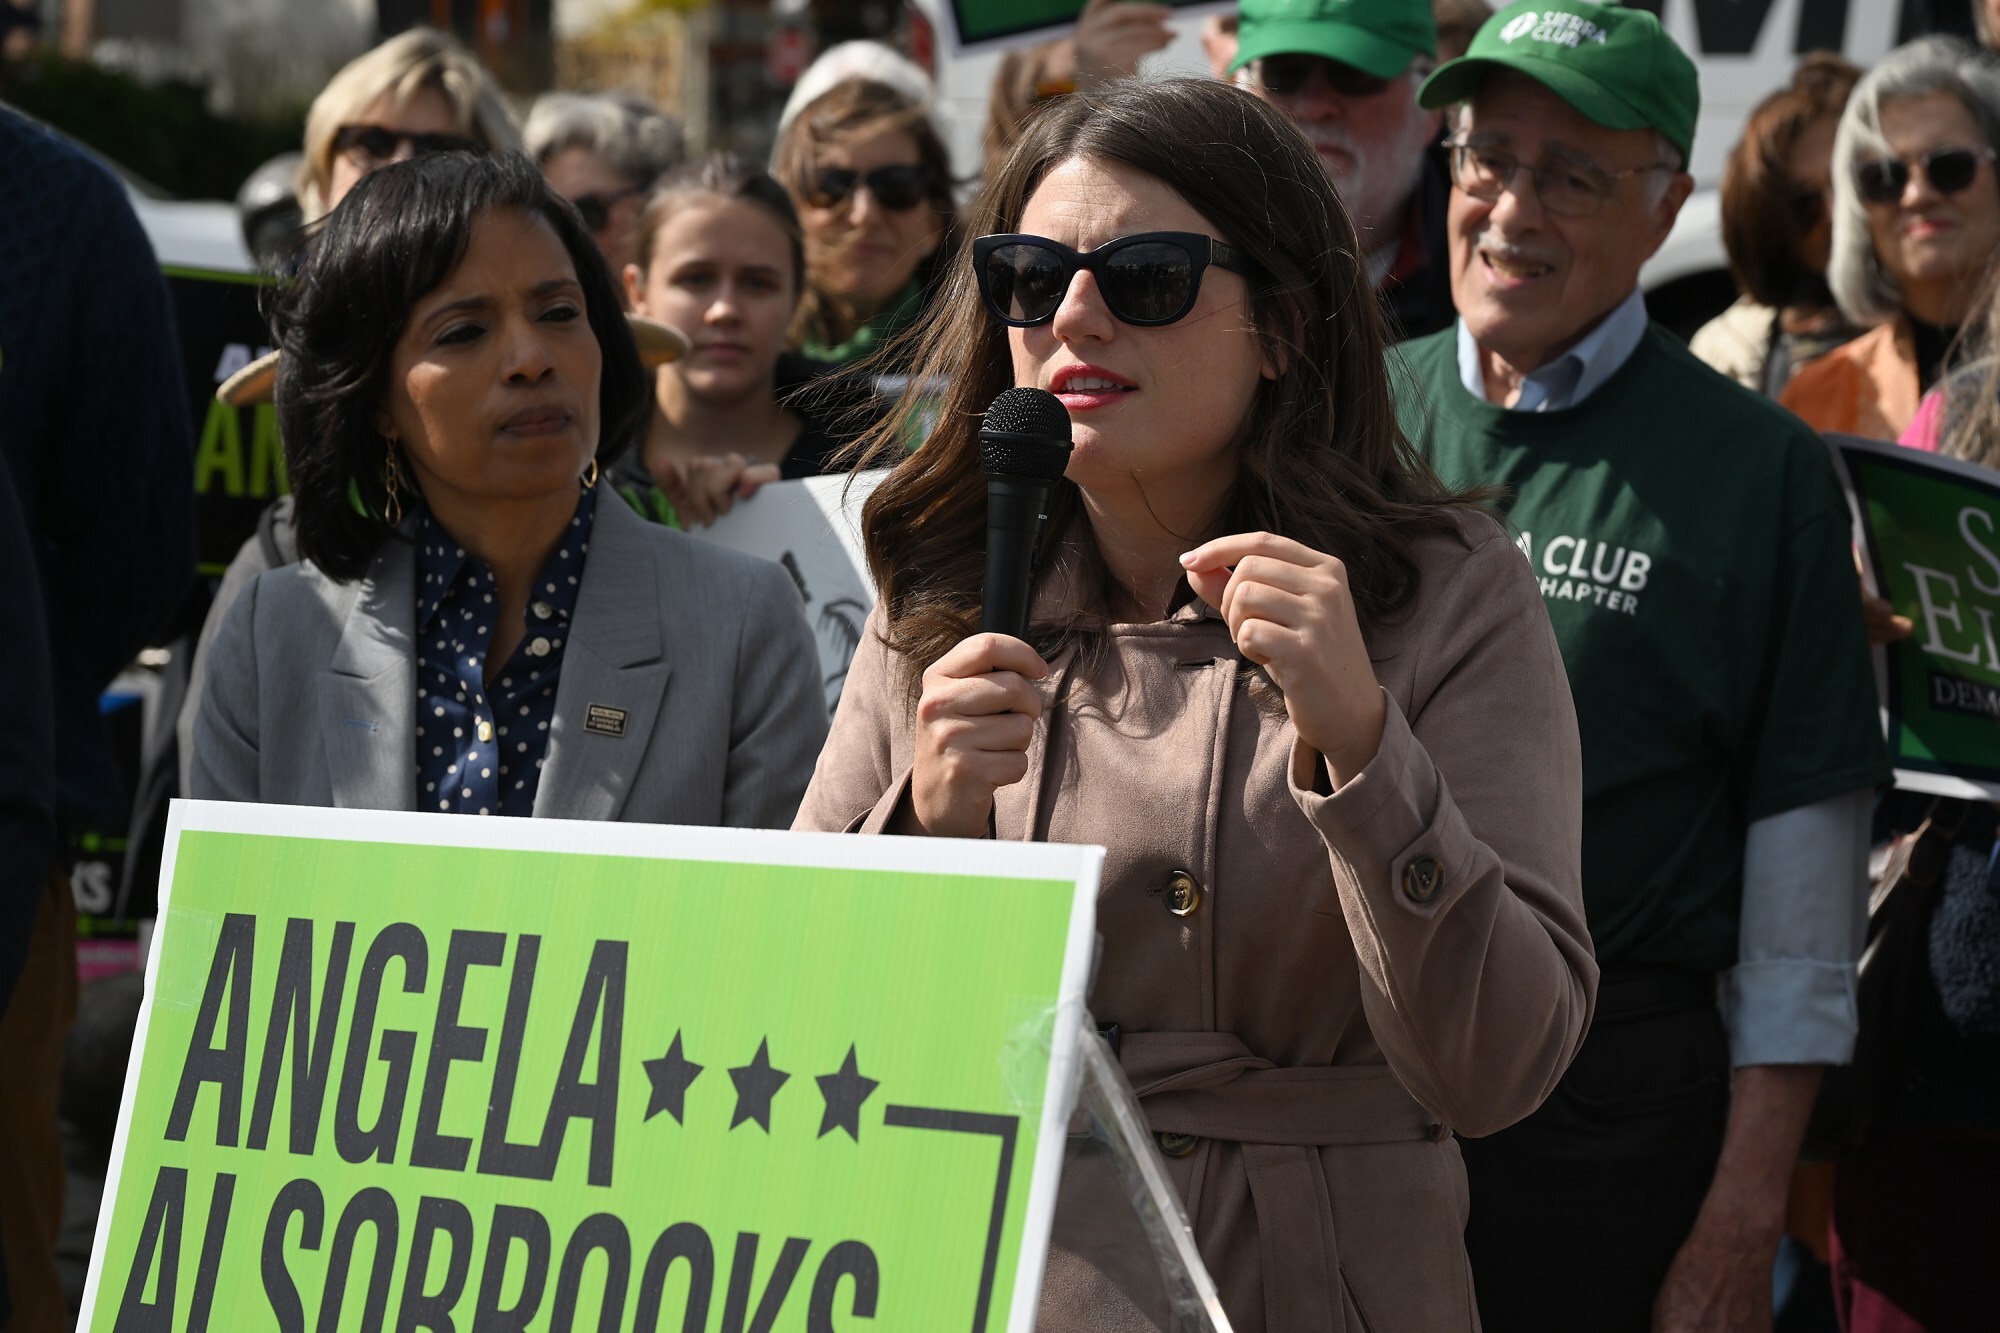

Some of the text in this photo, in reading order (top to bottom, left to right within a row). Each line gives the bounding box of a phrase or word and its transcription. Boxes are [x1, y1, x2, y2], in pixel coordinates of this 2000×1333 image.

[1531, 25, 1581, 48] CLUB
[1541, 10, 1606, 45] SIERRA
[1542, 534, 1652, 591] CLUB
[1535, 575, 1638, 616] HAPTER
[1933, 676, 2000, 717] DEM
[163, 912, 629, 1188] ANGELA
